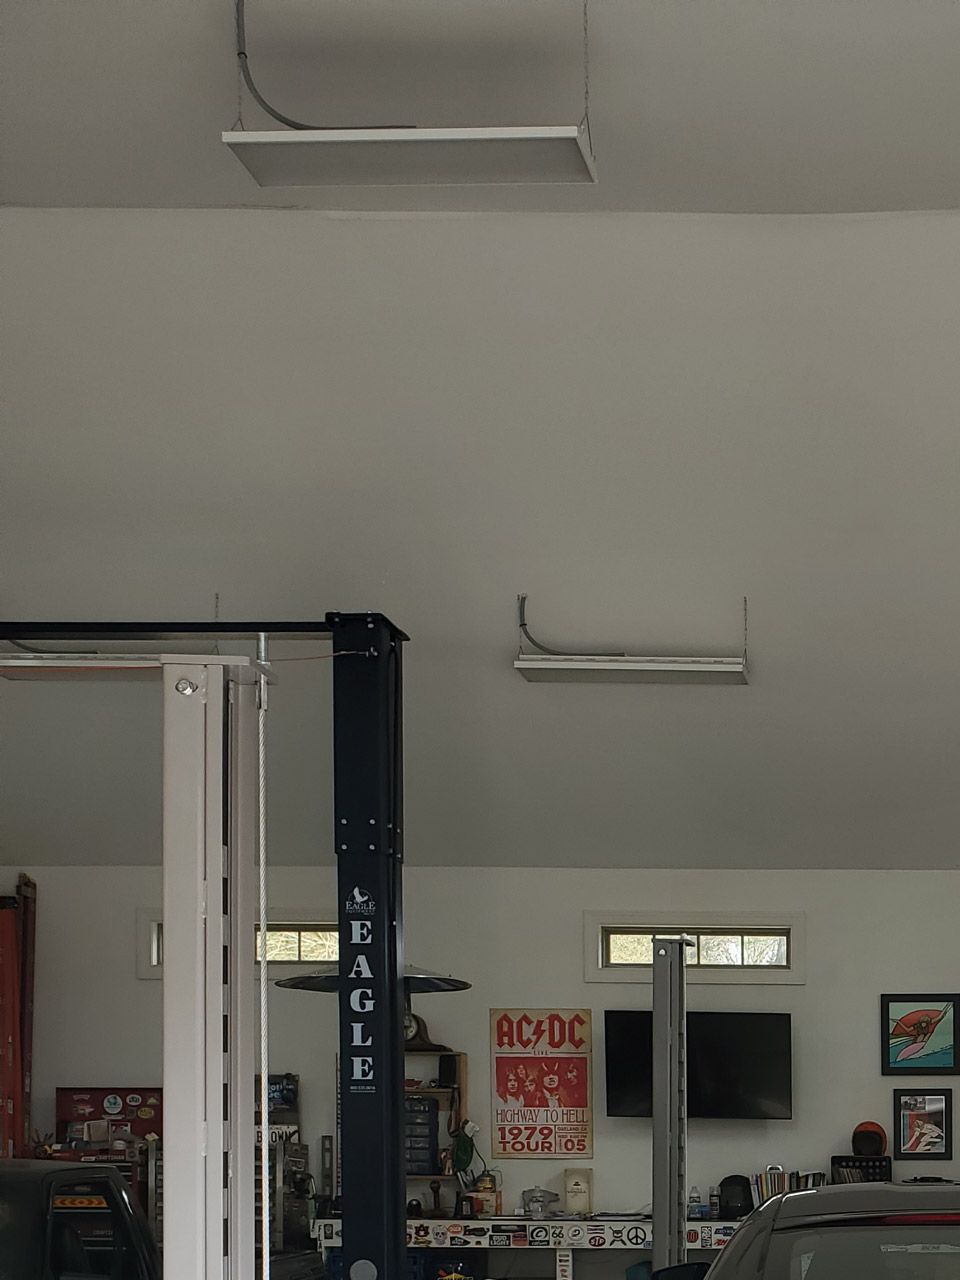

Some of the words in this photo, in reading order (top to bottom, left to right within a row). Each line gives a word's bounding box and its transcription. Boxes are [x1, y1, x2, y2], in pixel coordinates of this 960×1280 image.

[345, 901, 376, 910] EAGLE
[348, 920, 376, 1080] EAGLE
[496, 1109, 540, 1123] HIGHWAY
[544, 1109, 558, 1123] TO
[562, 1109, 588, 1123] HELL
[256, 1131, 292, 1143] BOWN
[498, 1126, 554, 1141] 1979
[499, 1141, 553, 1152] TOUR
[564, 1138, 586, 1152] 05
[551, 1230, 564, 1239] 66
[590, 1237, 605, 1245] STP
